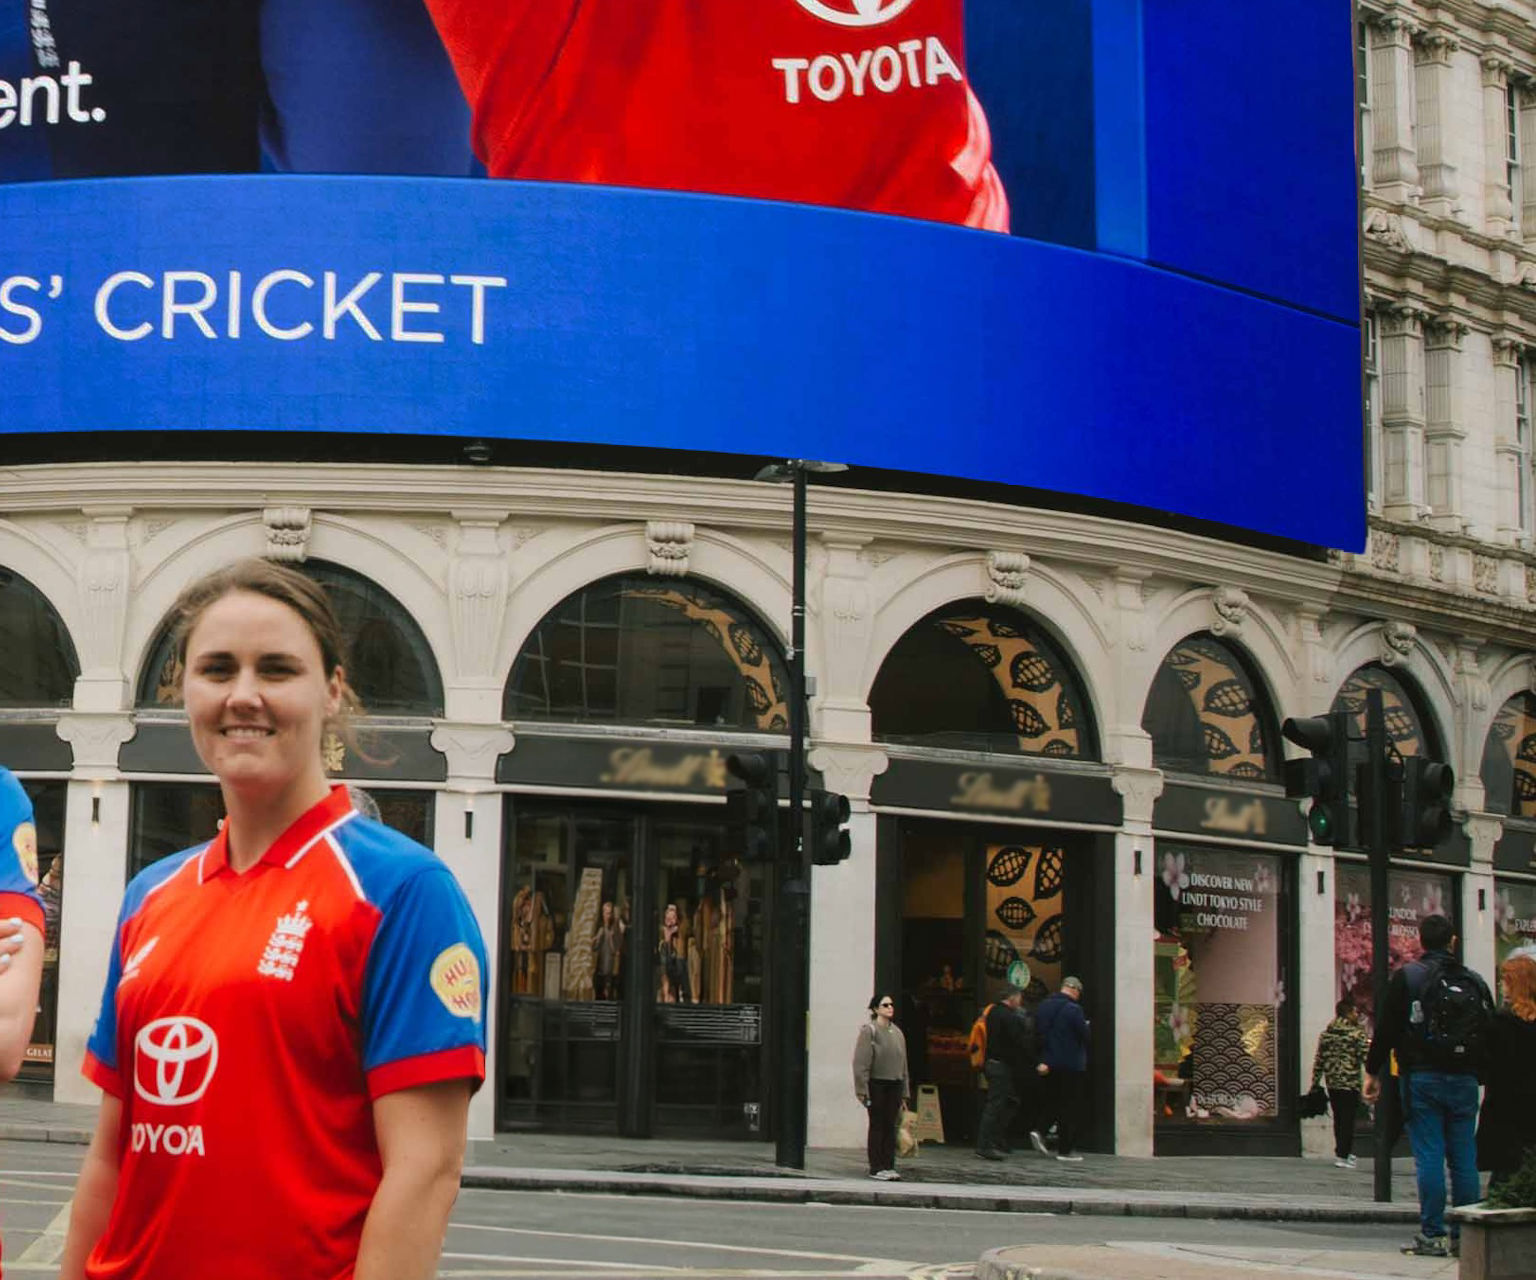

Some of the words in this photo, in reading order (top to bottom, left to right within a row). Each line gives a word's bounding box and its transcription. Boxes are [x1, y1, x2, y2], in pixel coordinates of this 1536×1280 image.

[771, 35, 964, 104] TOYOTA
[93, 269, 508, 346] CRICKET
[1190, 873, 1233, 890] DISCOVER
[1234, 877, 1252, 891] NEW
[1182, 892, 1208, 907] LINDT
[1239, 897, 1263, 912] STYLE
[1196, 912, 1249, 930] CHOCOLATE
